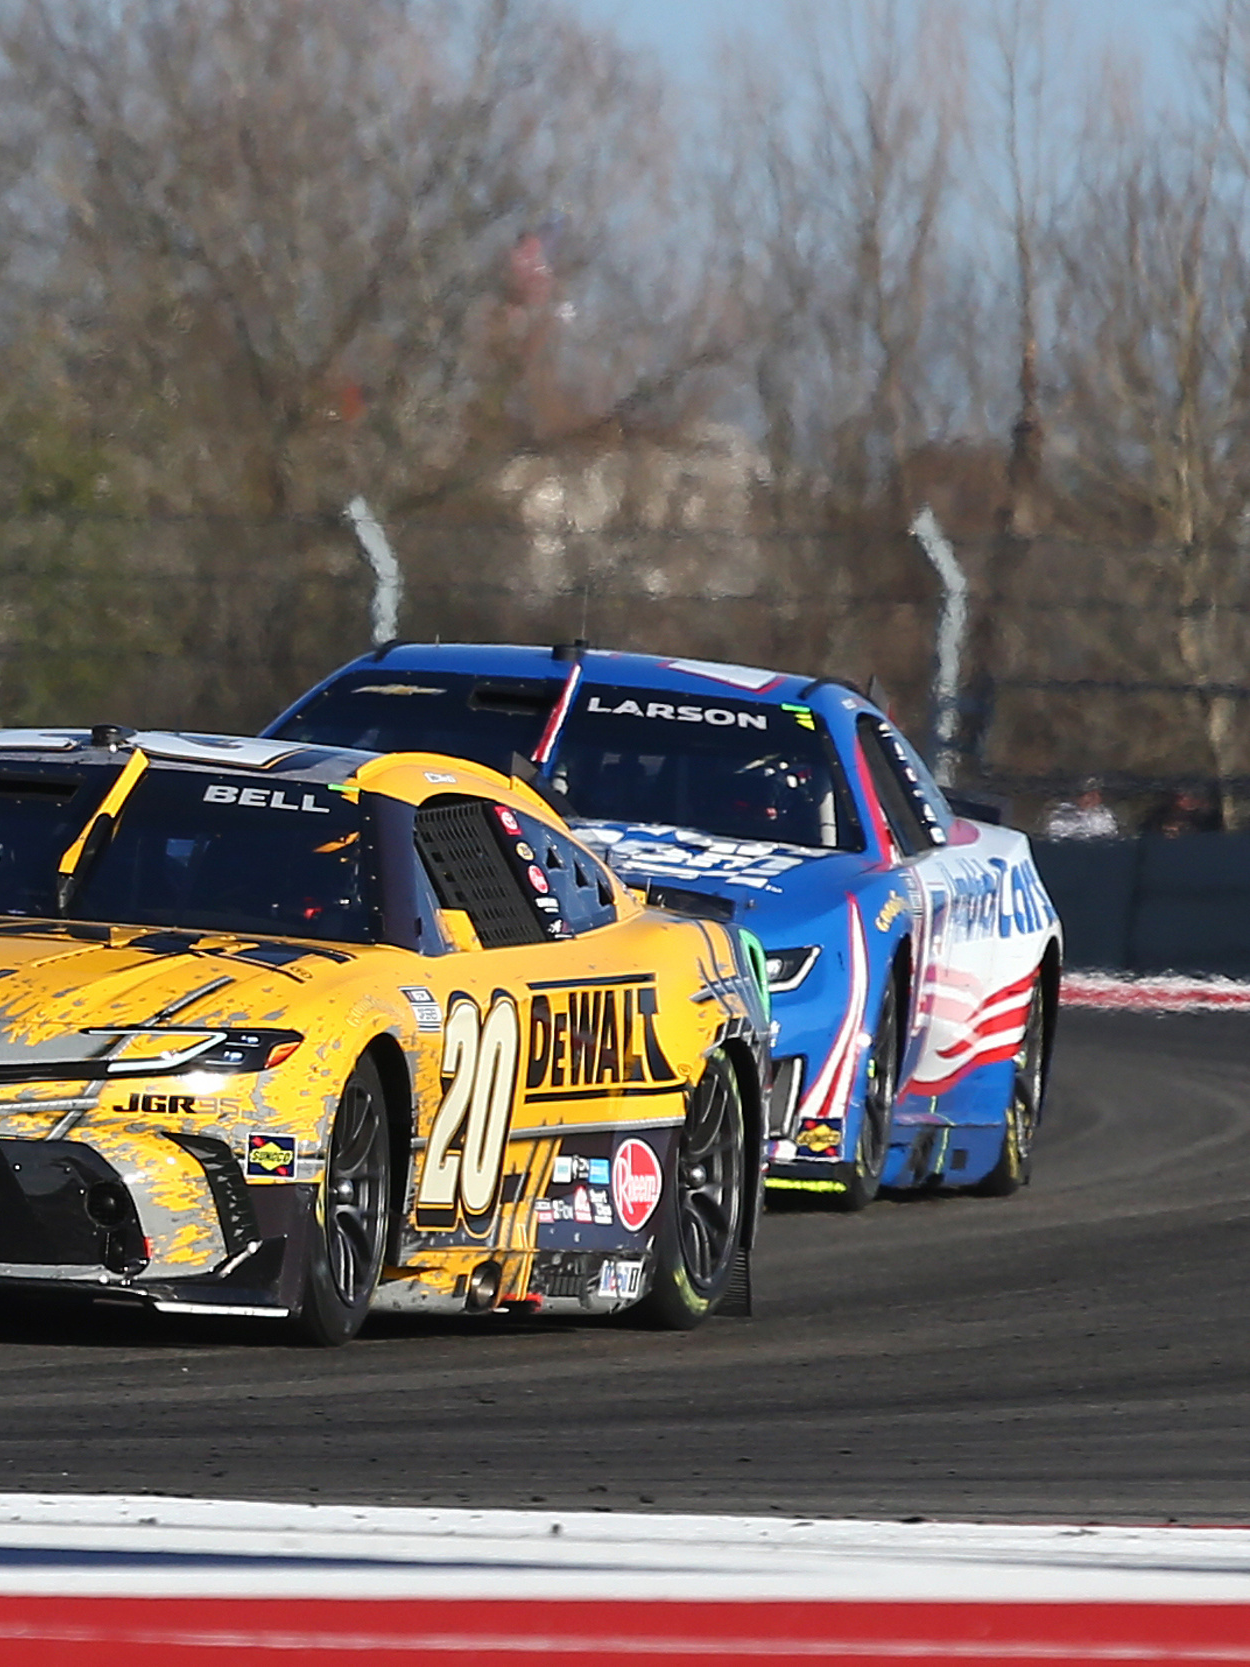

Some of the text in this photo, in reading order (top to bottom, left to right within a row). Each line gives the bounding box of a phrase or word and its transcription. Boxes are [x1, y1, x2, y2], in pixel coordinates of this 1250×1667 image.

[587, 697, 767, 730] LARSON
[203, 785, 330, 813] BELL
[525, 987, 679, 1090] DEWALT
[416, 990, 520, 1232] 20
[616, 1143, 659, 1214] Rheem
